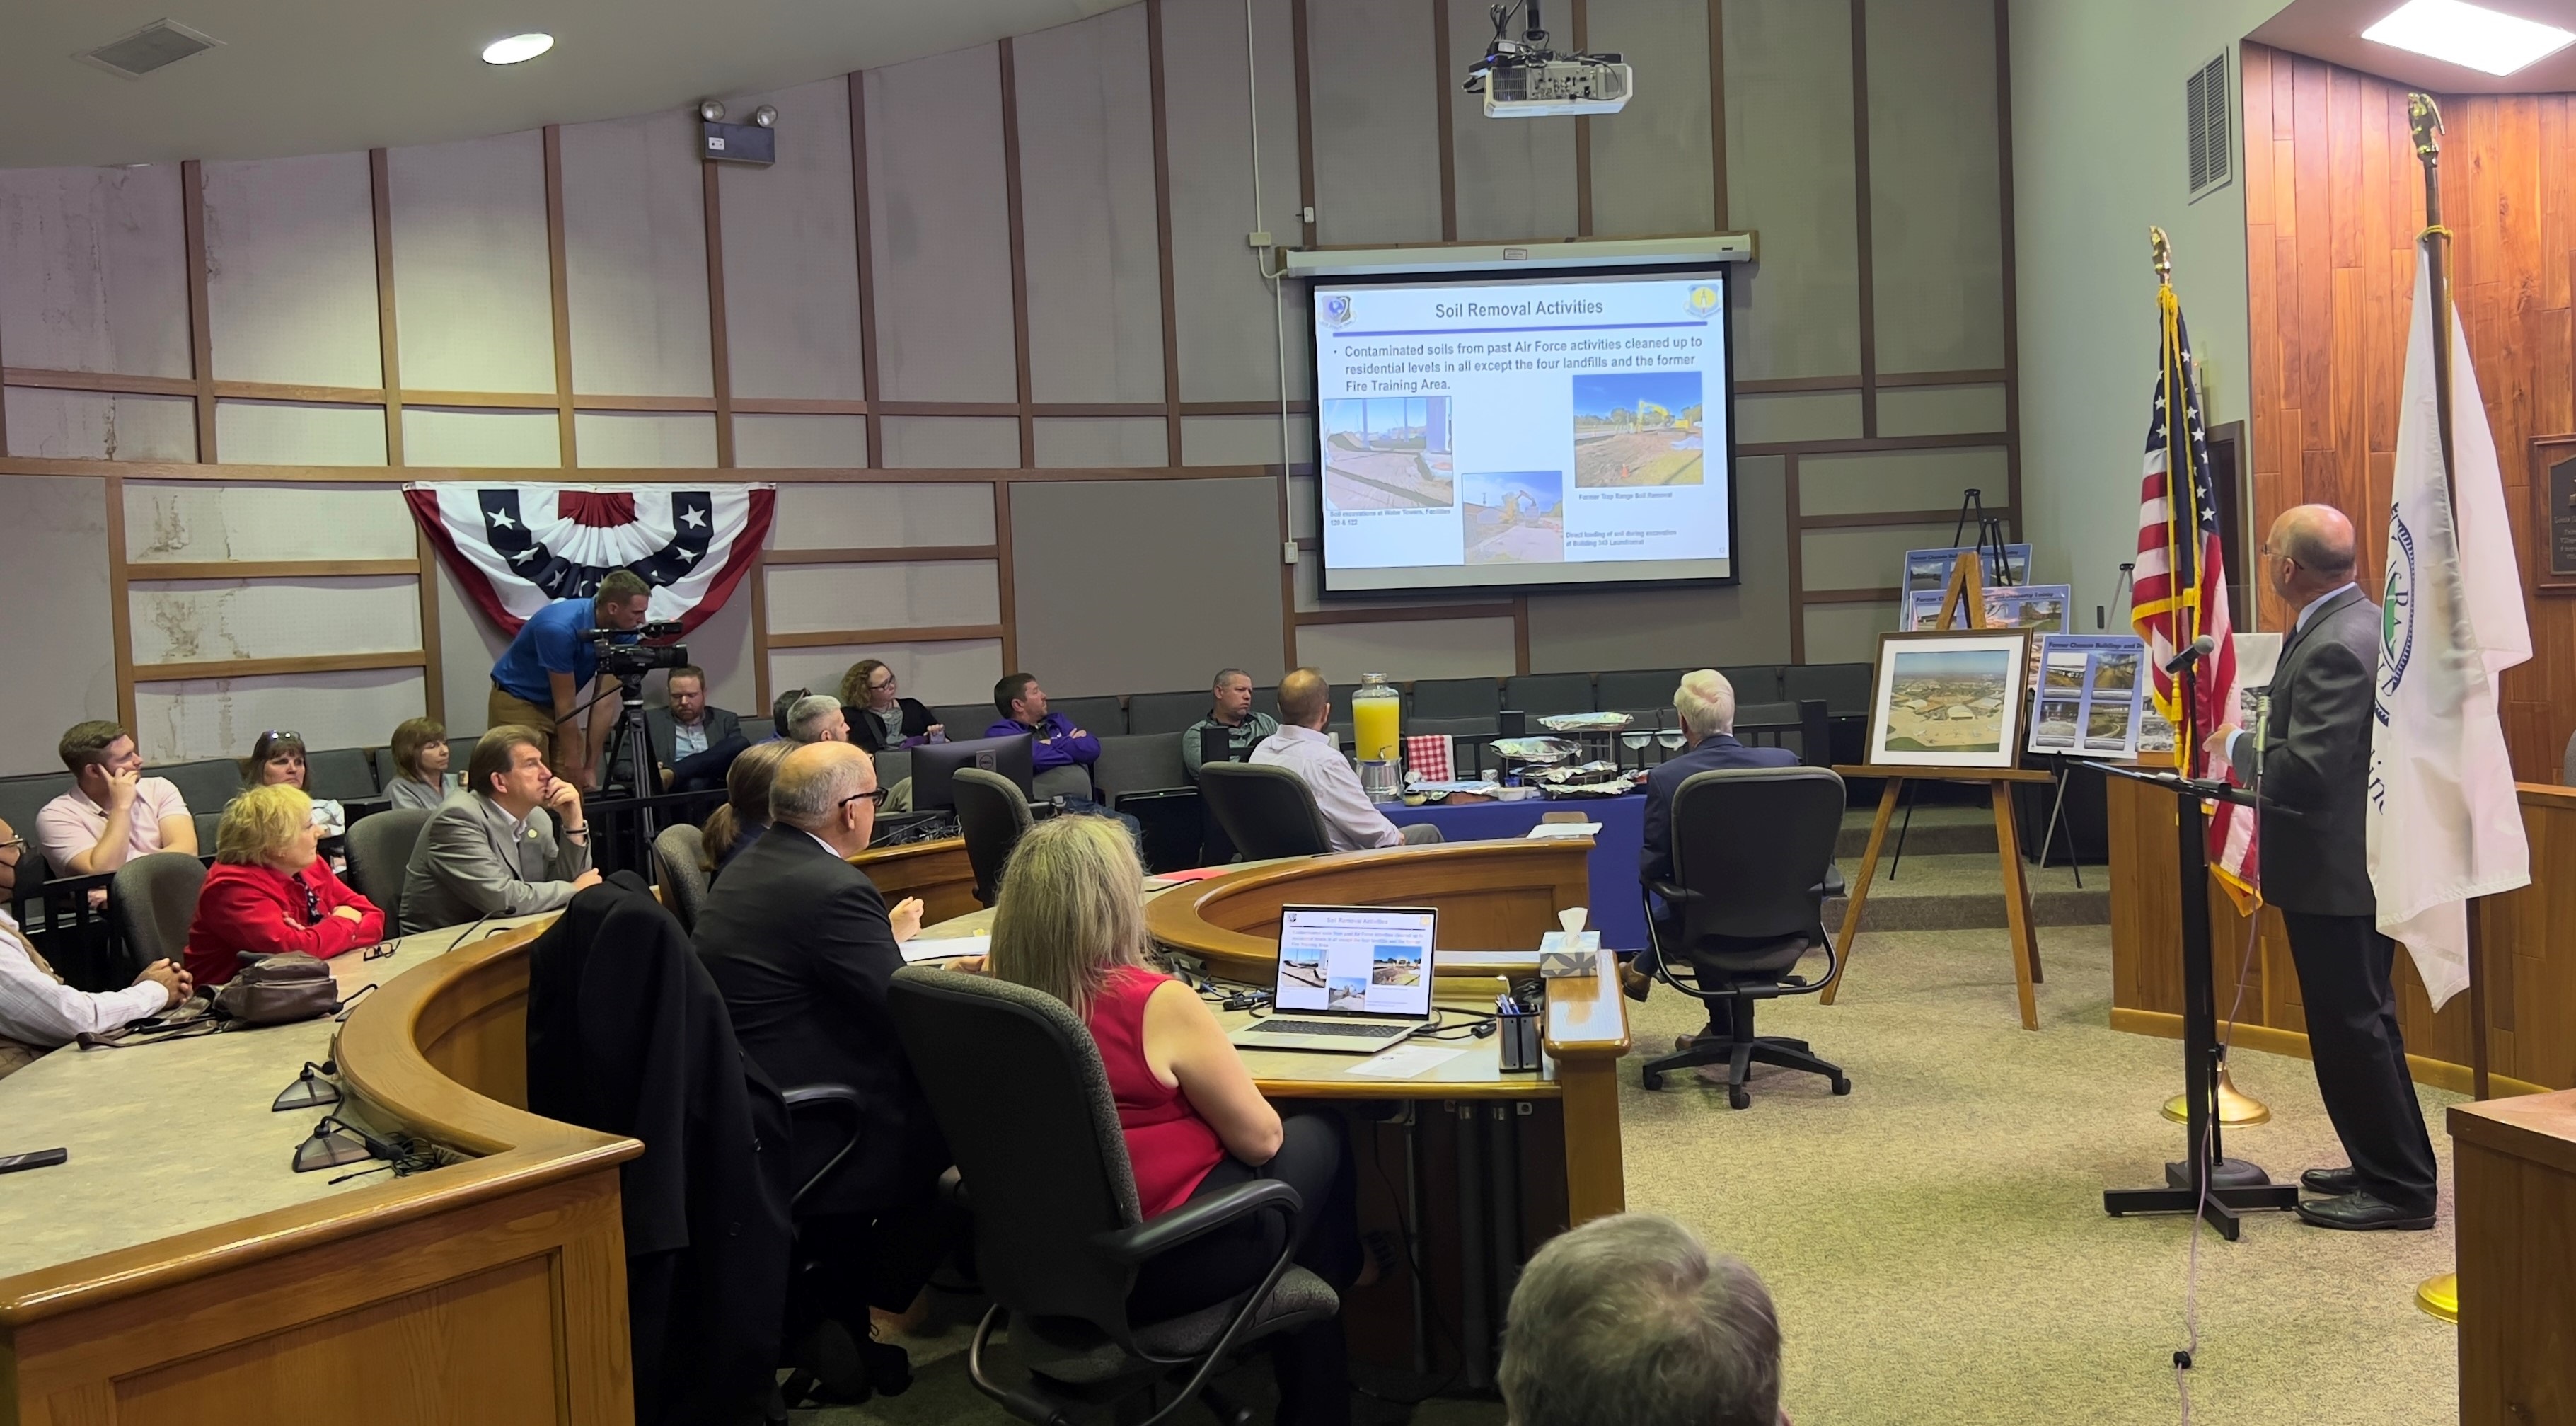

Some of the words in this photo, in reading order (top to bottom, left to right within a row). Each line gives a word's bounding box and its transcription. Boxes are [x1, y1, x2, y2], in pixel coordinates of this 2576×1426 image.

[1436, 303, 1462, 318] Soil
[1468, 301, 1531, 317] Removal
[1535, 299, 1603, 315] Activities
[1345, 344, 1423, 357] Contaminated
[1427, 343, 1454, 355] soils
[1457, 343, 1484, 355] from
[1487, 342, 1512, 357] past
[1515, 341, 1532, 352] Air
[1535, 340, 1567, 352] Force
[1571, 338, 1622, 350] activities
[1625, 337, 1670, 349] cleaned
[1673, 338, 1687, 350] up
[1691, 336, 1702, 347] to
[1346, 360, 1404, 375] residential
[1408, 360, 1441, 374] levels
[1445, 360, 1455, 372] in
[1458, 360, 1471, 372] all
[1474, 360, 1512, 373] except
[1515, 358, 1533, 370] the
[1537, 358, 1560, 369] four
[1563, 356, 1607, 369] landfills
[1611, 355, 1632, 367] and
[1636, 355, 1653, 366] the
[1657, 355, 1695, 366] former
[1346, 380, 1368, 392] Fire
[1371, 379, 1417, 393] Training
[1421, 378, 1451, 391] Area.
